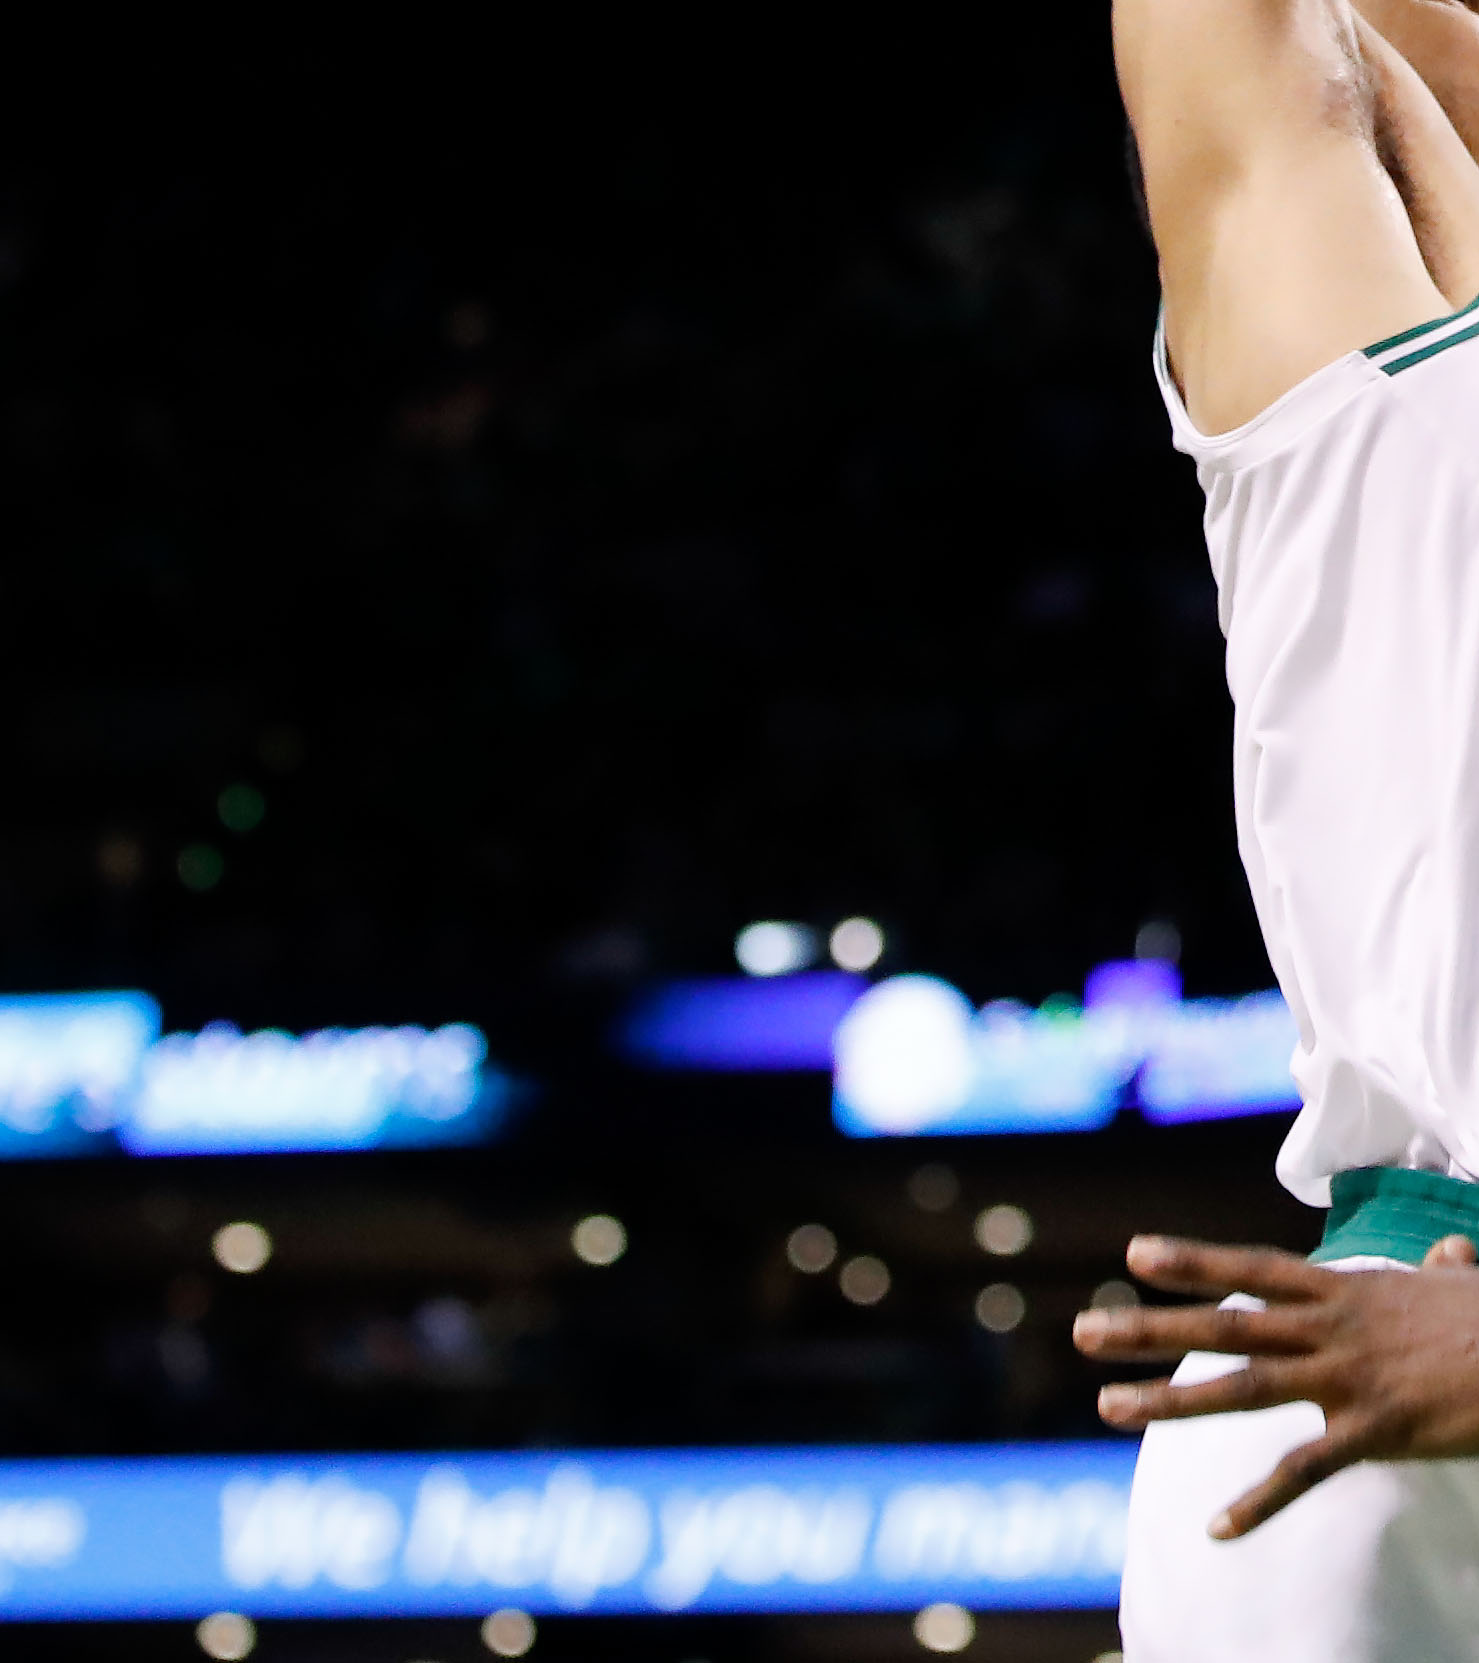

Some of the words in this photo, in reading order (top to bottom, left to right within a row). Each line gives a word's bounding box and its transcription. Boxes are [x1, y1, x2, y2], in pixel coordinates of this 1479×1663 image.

[221, 1470, 400, 1589] We
[406, 1464, 650, 1609] help
[645, 1484, 872, 1611] you
